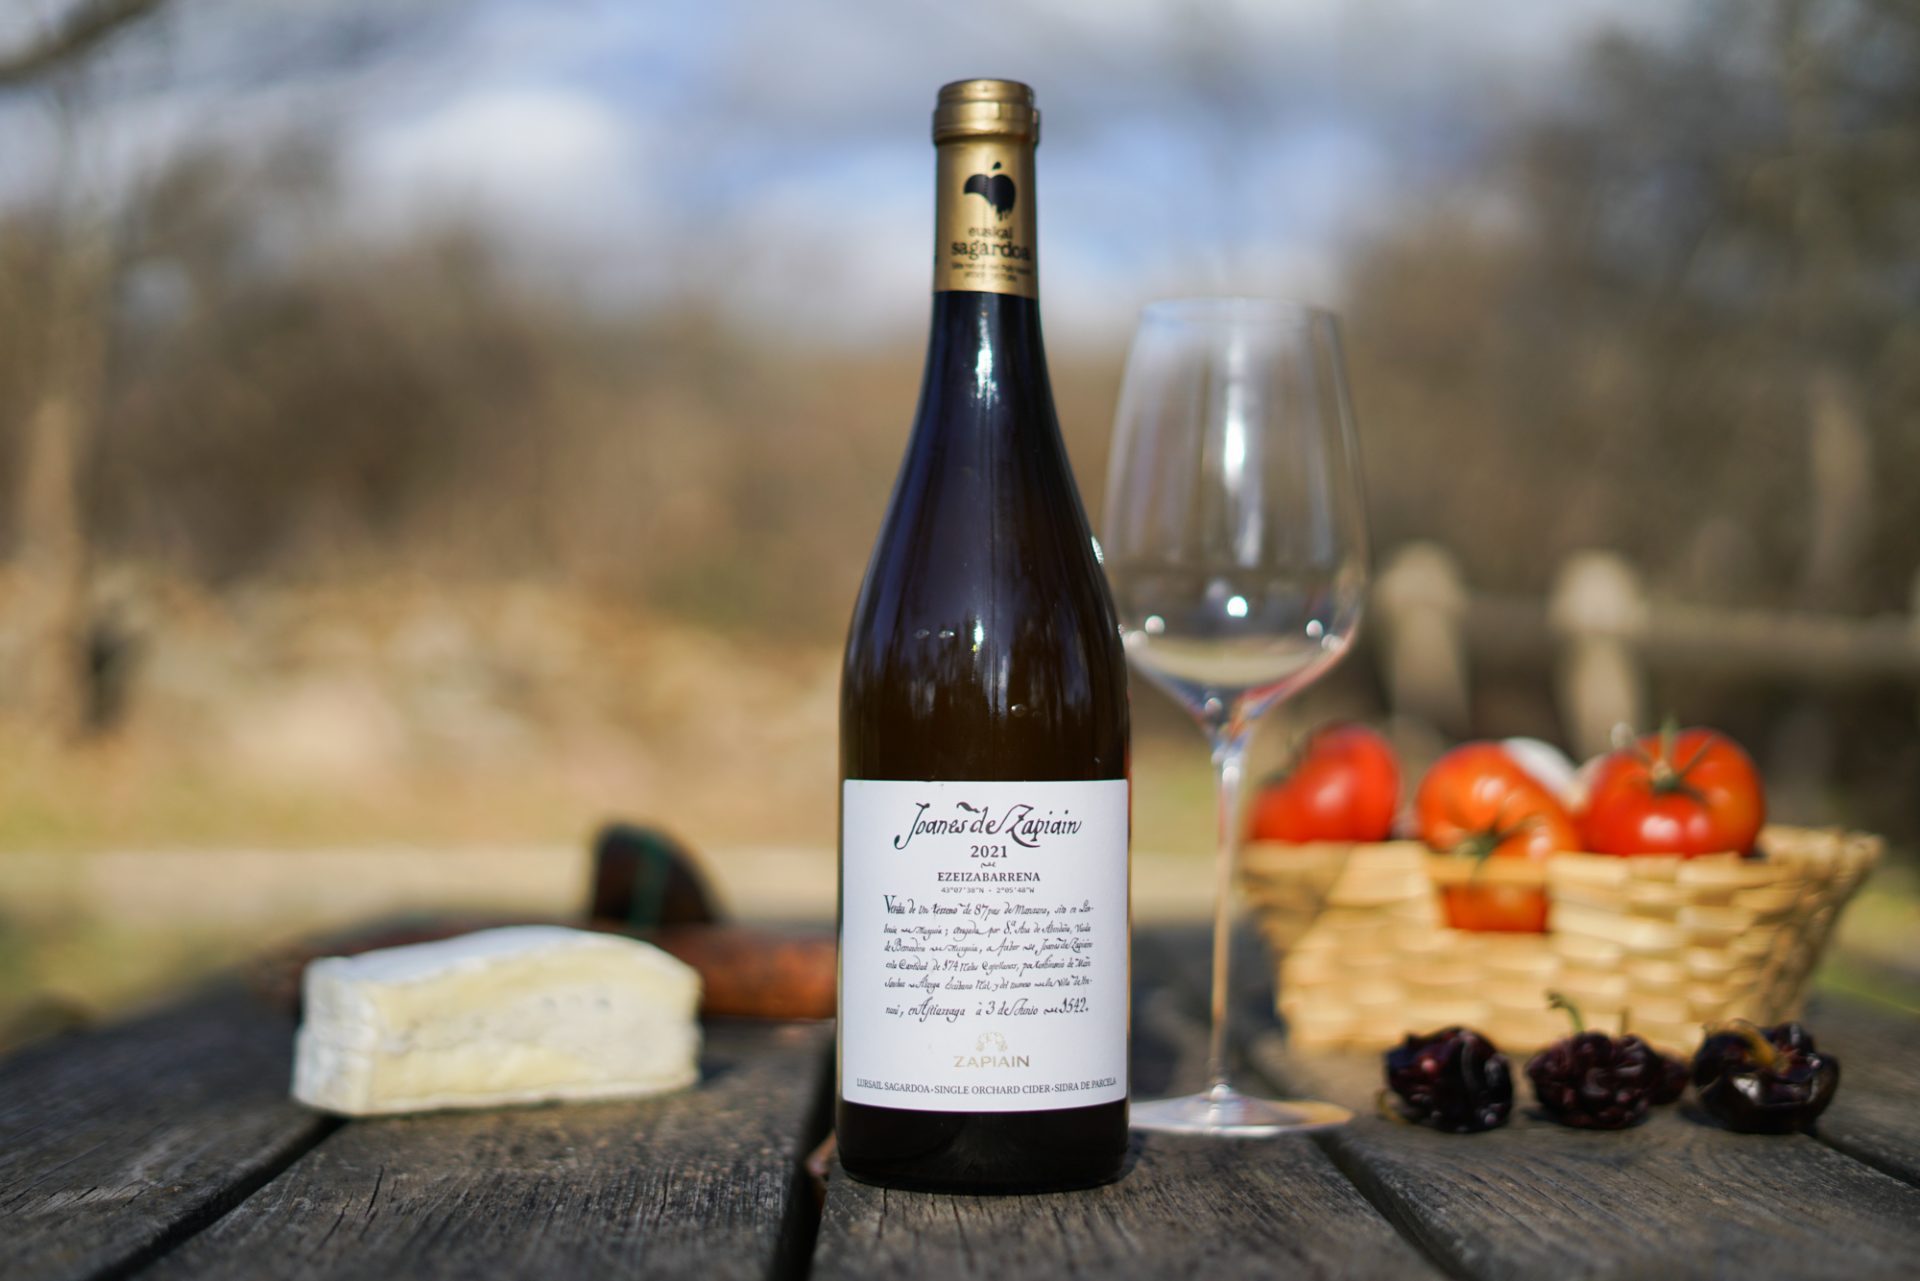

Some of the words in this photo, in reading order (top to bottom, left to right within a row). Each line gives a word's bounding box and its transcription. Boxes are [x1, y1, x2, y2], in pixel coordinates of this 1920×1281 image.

[951, 240, 1030, 261] sagardoa
[893, 802, 965, 850] Joanes
[964, 802, 1001, 835] de
[999, 803, 1082, 848] Zapiain
[970, 845, 1008, 858] 2021
[937, 871, 1041, 882] EZEIZABARRENA
[985, 1000, 996, 1015] 3
[953, 1055, 1030, 1068] ZAPIAIN
[971, 1085, 1020, 1095] ORCHARD
[1080, 1080, 1091, 1090] DE
